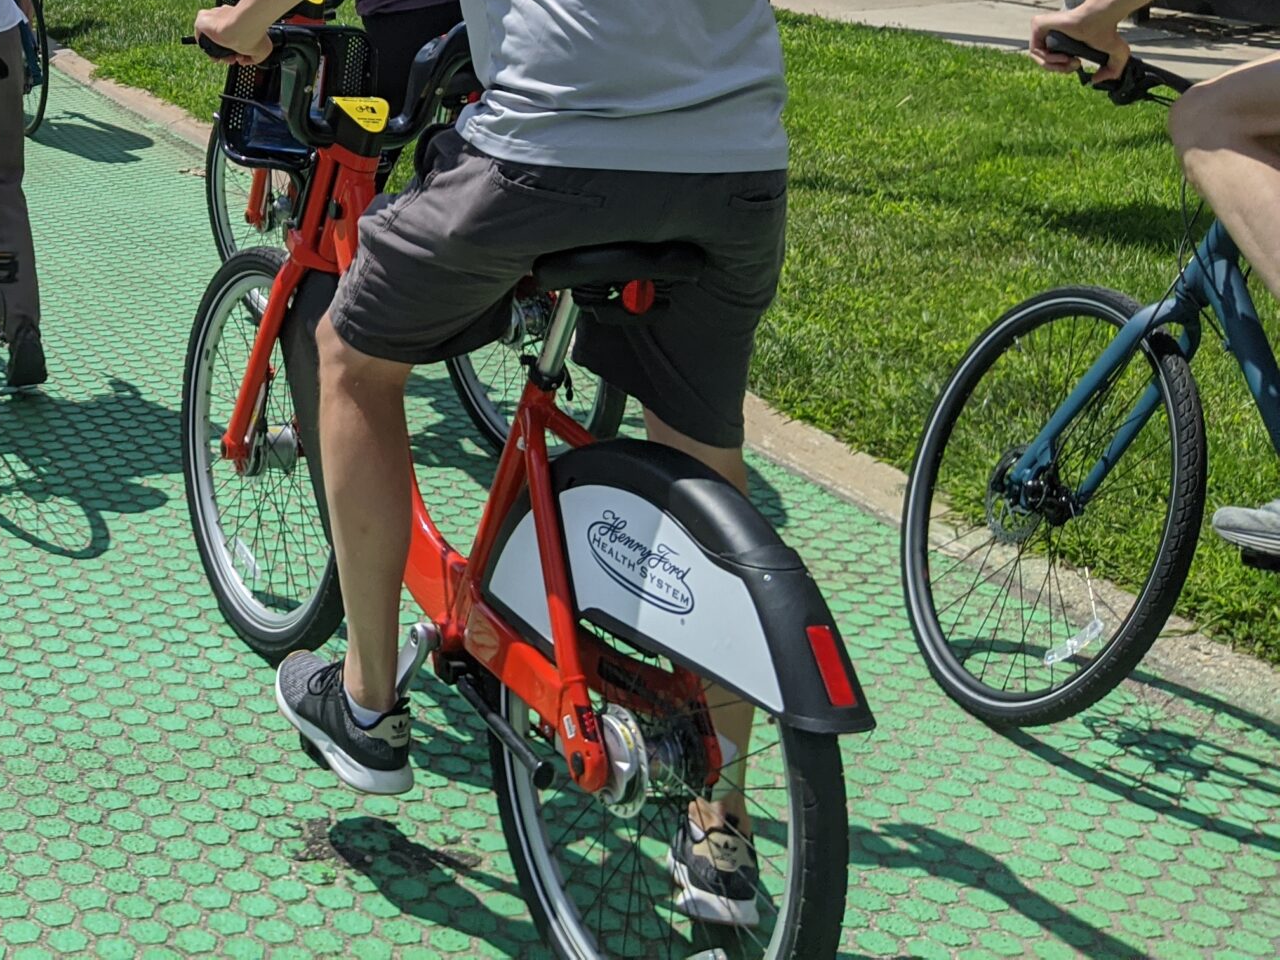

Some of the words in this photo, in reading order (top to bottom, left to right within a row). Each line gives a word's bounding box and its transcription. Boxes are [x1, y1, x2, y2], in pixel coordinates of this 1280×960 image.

[592, 533, 636, 571] HEALTH
[639, 565, 690, 607] SYSTEM
[598, 509, 653, 565] Henry
[648, 543, 691, 581] Ford
